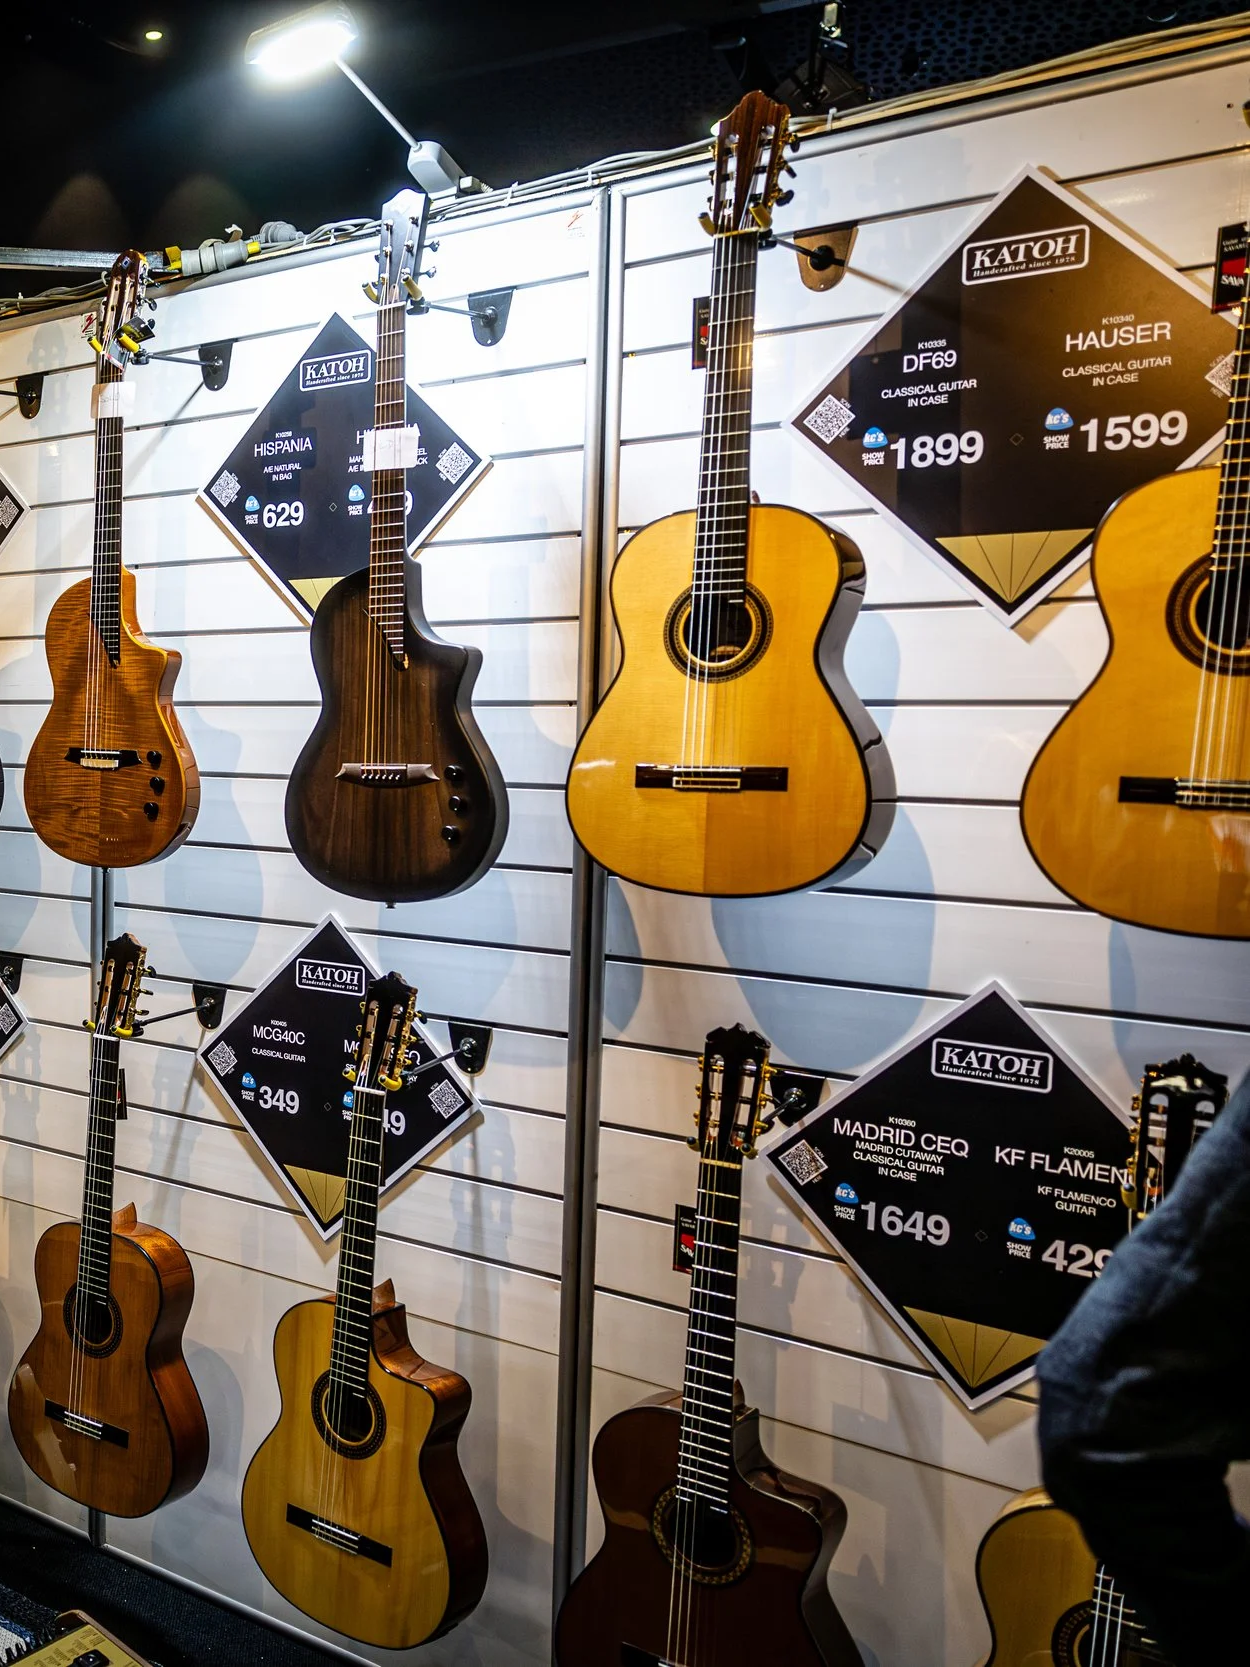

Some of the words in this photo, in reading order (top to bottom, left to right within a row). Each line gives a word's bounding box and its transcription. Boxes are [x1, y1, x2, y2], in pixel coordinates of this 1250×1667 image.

[972, 234, 1079, 270] KATOH
[973, 264, 1025, 277] Handcrafted
[1029, 260, 1051, 268] since
[1102, 315, 1134, 325] K10340
[1065, 321, 1171, 352] HAUSER
[305, 357, 365, 380] KATOH
[903, 350, 957, 373] DF69
[1062, 361, 1125, 378] CLASSICAL
[1128, 356, 1171, 370] GUITAR
[306, 377, 336, 385] Handcrafted
[1093, 377, 1104, 387] IN
[1106, 373, 1139, 385] CASE
[881, 385, 936, 399] CLASSICAL
[938, 379, 977, 391] GUITAR
[908, 398, 919, 407] IN
[920, 395, 948, 406] CASE
[864, 431, 884, 443] kc's
[1043, 434, 1070, 444] SHOW
[1080, 410, 1188, 452] 1599
[254, 437, 312, 457] HISPANIA
[890, 430, 984, 469] 1899
[1045, 441, 1069, 450] PRICE
[862, 452, 884, 461] SHOW
[864, 458, 884, 466] PRICE
[274, 463, 301, 471] NATURAL
[263, 501, 304, 528] 629
[301, 965, 360, 985] KATOH
[302, 979, 331, 987] Handcrafted
[253, 1025, 305, 1045] MCG40C
[252, 1047, 283, 1059] CLASSICAL
[284, 1053, 305, 1062] GUITAR
[941, 1046, 1044, 1077] KATOH
[942, 1065, 992, 1078] Handcrafted
[995, 1073, 1016, 1081] since
[1020, 1077, 1040, 1085] 1978
[259, 1085, 300, 1114] 349
[833, 1117, 916, 1147] MADRID
[920, 1133, 969, 1158] CEQ
[855, 1140, 894, 1155] MADRID
[895, 1147, 943, 1164] CUTAWAY
[1063, 1147, 1095, 1159] K20005
[853, 1151, 905, 1169] CLASSICAL
[907, 1160, 945, 1176] GUITAR
[995, 1146, 1025, 1166] KF
[1030, 1152, 1130, 1185] FLAMEN
[878, 1167, 888, 1176] IN
[890, 1169, 917, 1182] CASE
[836, 1186, 855, 1199] kc's
[1038, 1185, 1052, 1195] KF
[1054, 1188, 1117, 1208] FLAMENCO
[834, 1205, 856, 1214] SHOW
[836, 1212, 855, 1221] PRICE
[1055, 1200, 1097, 1217] GUITAR
[861, 1201, 950, 1246] 1649
[1009, 1221, 1032, 1236] kc's
[1006, 1241, 1031, 1251] SHOW
[1009, 1249, 1031, 1259] PRICE
